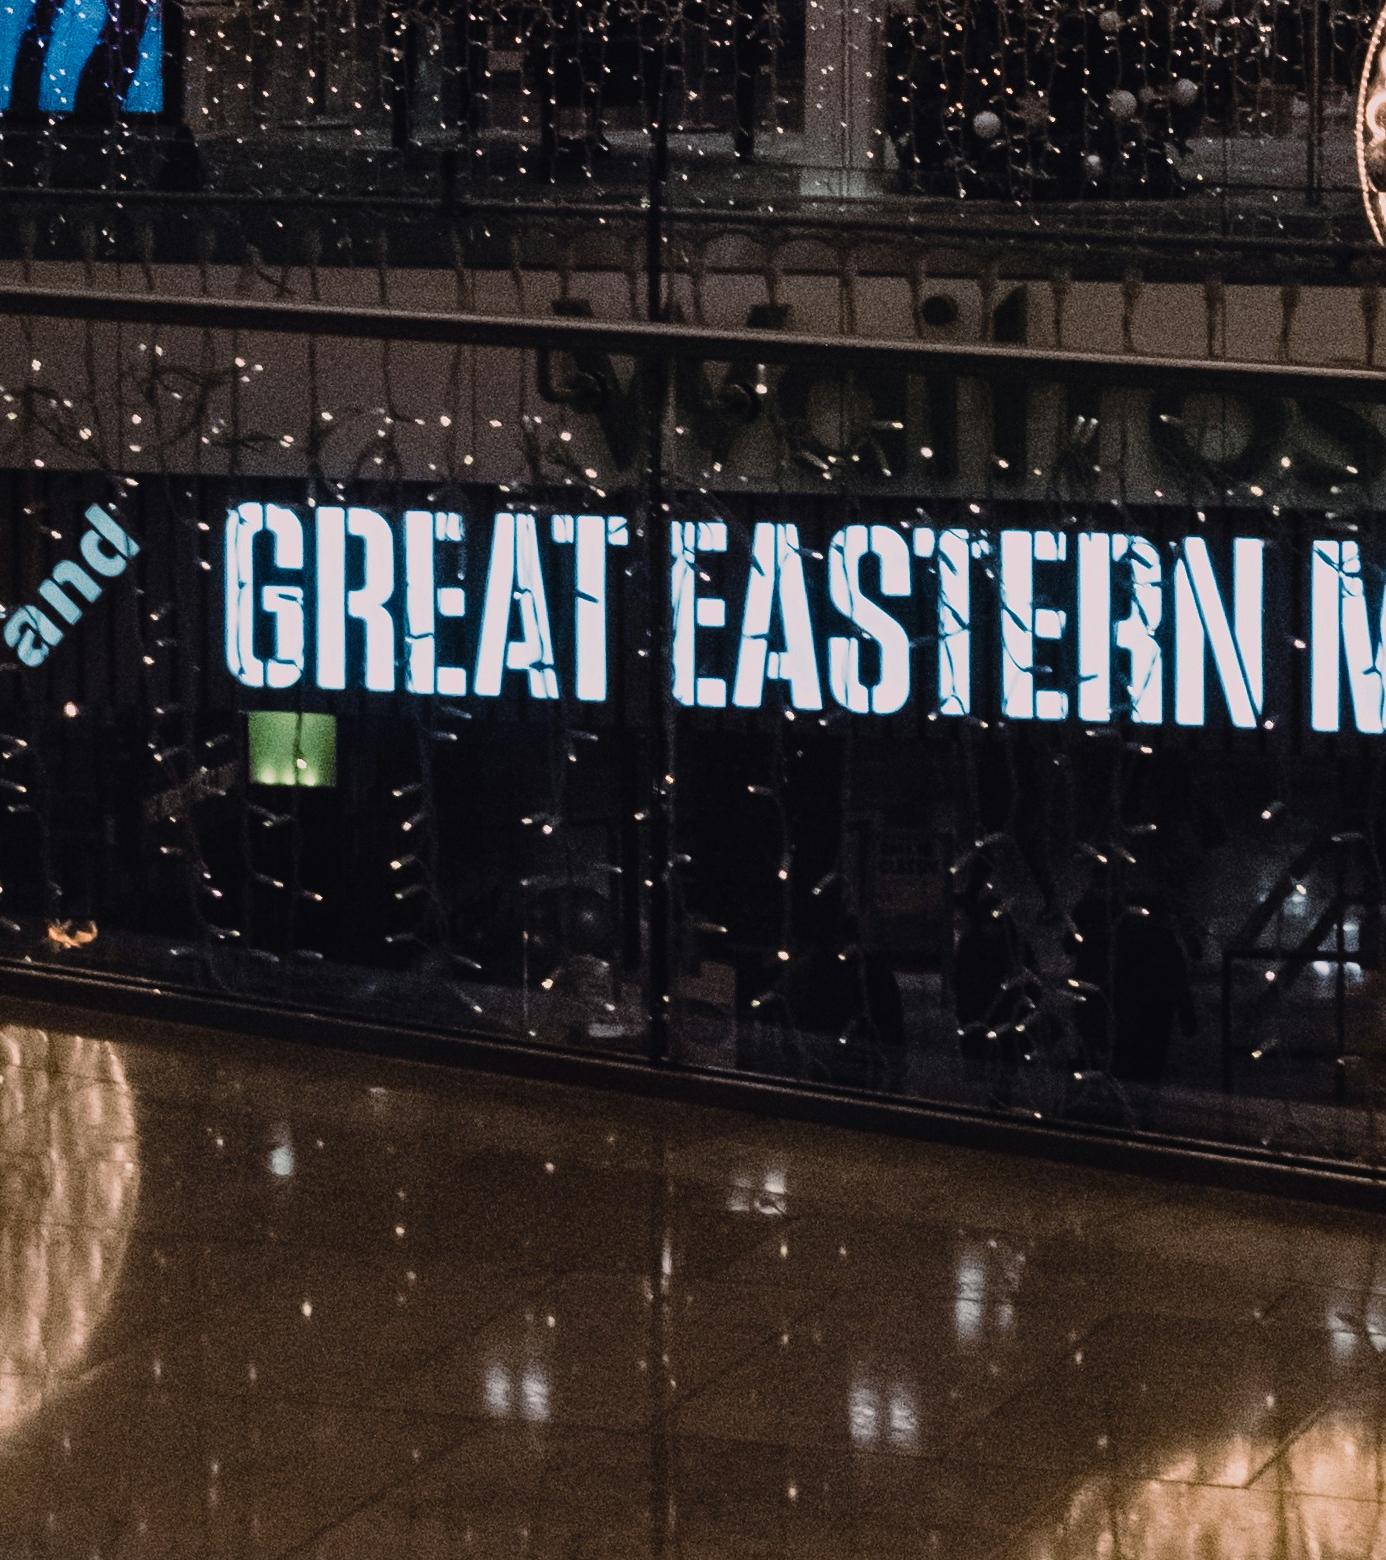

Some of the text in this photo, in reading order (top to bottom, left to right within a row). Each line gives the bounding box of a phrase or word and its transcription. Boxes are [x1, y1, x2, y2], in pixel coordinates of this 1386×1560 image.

[1, 501, 141, 670] and
[224, 500, 629, 704] GREAT
[667, 519, 1266, 730] EASTERN
